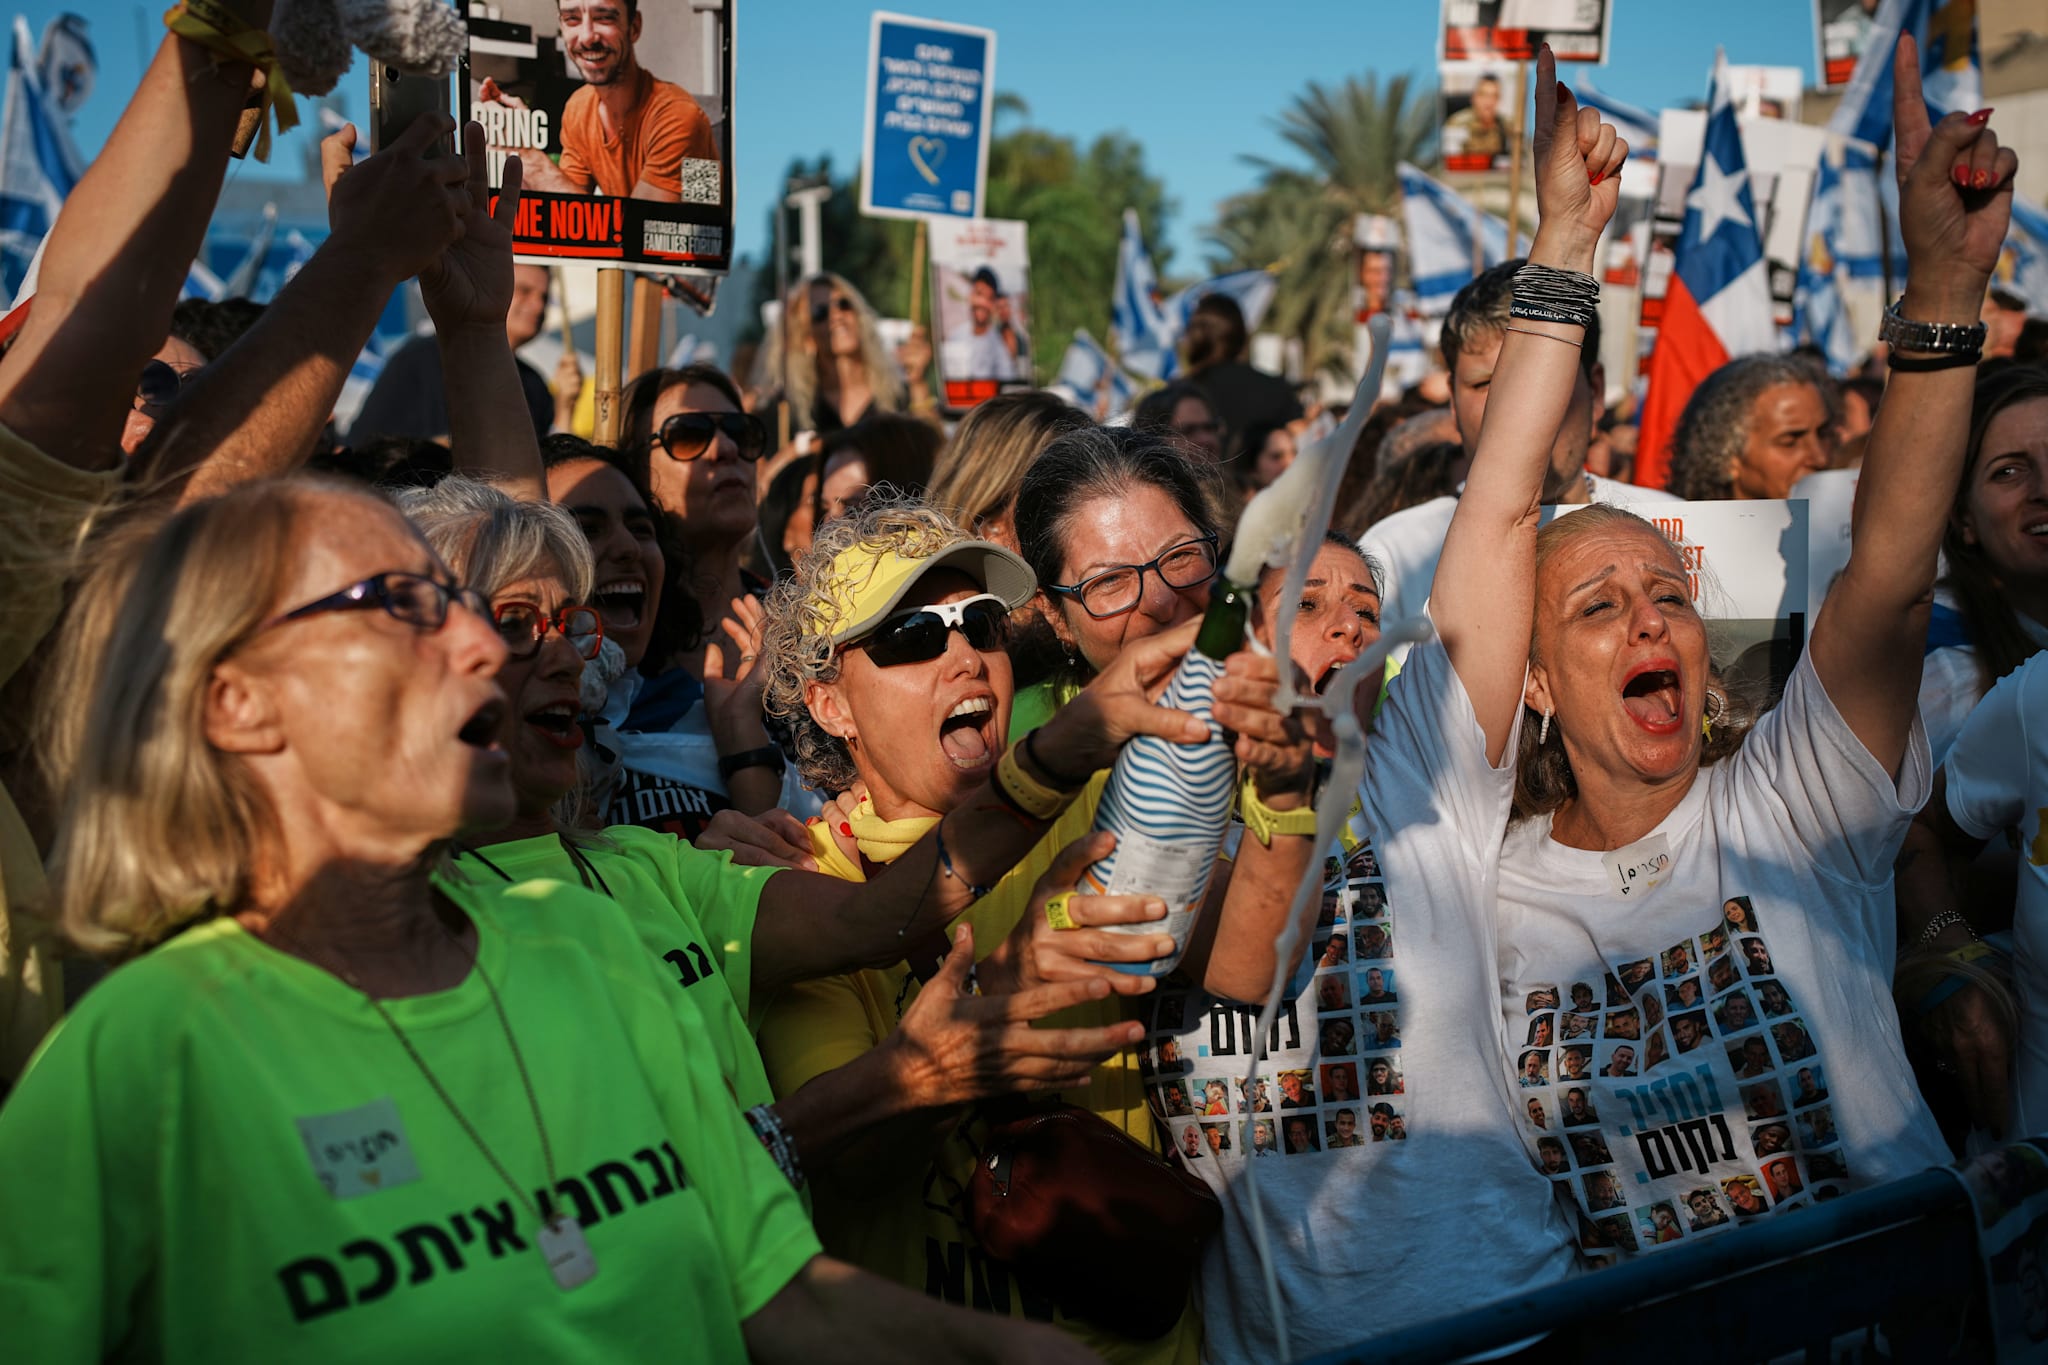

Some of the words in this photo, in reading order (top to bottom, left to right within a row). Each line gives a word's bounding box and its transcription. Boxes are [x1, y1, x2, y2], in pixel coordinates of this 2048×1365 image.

[470, 100, 548, 149] BRING
[550, 199, 624, 243] NOW!
[643, 232, 687, 254] FAMILIES
[688, 237, 722, 256] FORUM
[636, 787, 712, 820] אותם
[276, 1199, 528, 1324] איתכם
